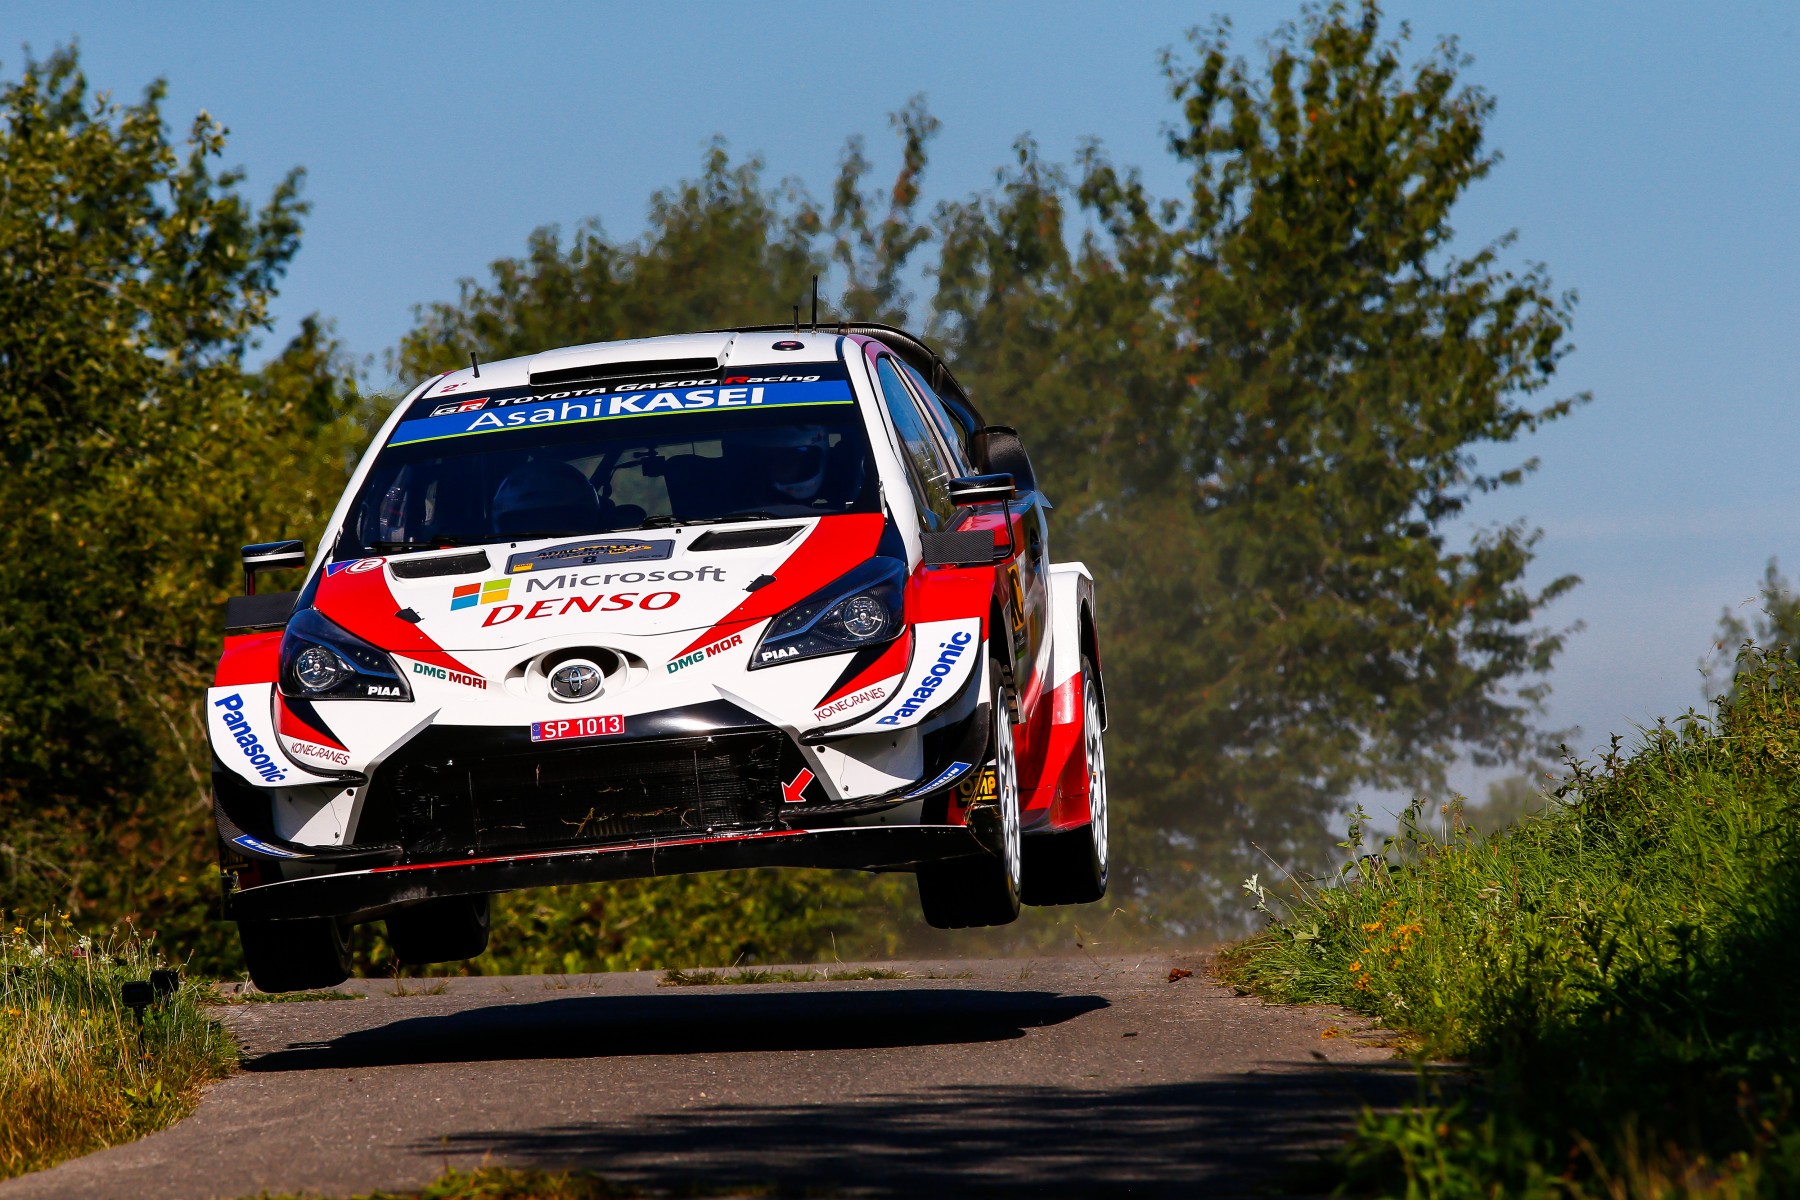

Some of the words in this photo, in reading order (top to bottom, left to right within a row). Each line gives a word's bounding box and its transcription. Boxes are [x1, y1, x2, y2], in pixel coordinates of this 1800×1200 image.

[494, 387, 606, 406] TOYOTA
[614, 378, 718, 392] GAZOO
[723, 375, 821, 384] Racing
[582, 555, 597, 564] 8
[525, 566, 727, 593] Microsoft
[481, 591, 681, 628] DENSO
[666, 650, 704, 674] DMG
[761, 646, 800, 661] PIAA
[413, 662, 447, 680] DMG
[448, 671, 487, 690] MORI
[875, 631, 972, 726] Panasonic
[367, 686, 401, 696] PIAA
[814, 687, 886, 722] KONECRANES
[214, 693, 288, 783] Panasonic
[544, 721, 570, 738] SP
[576, 716, 620, 735] 1013
[290, 742, 351, 766] KONECRANES
